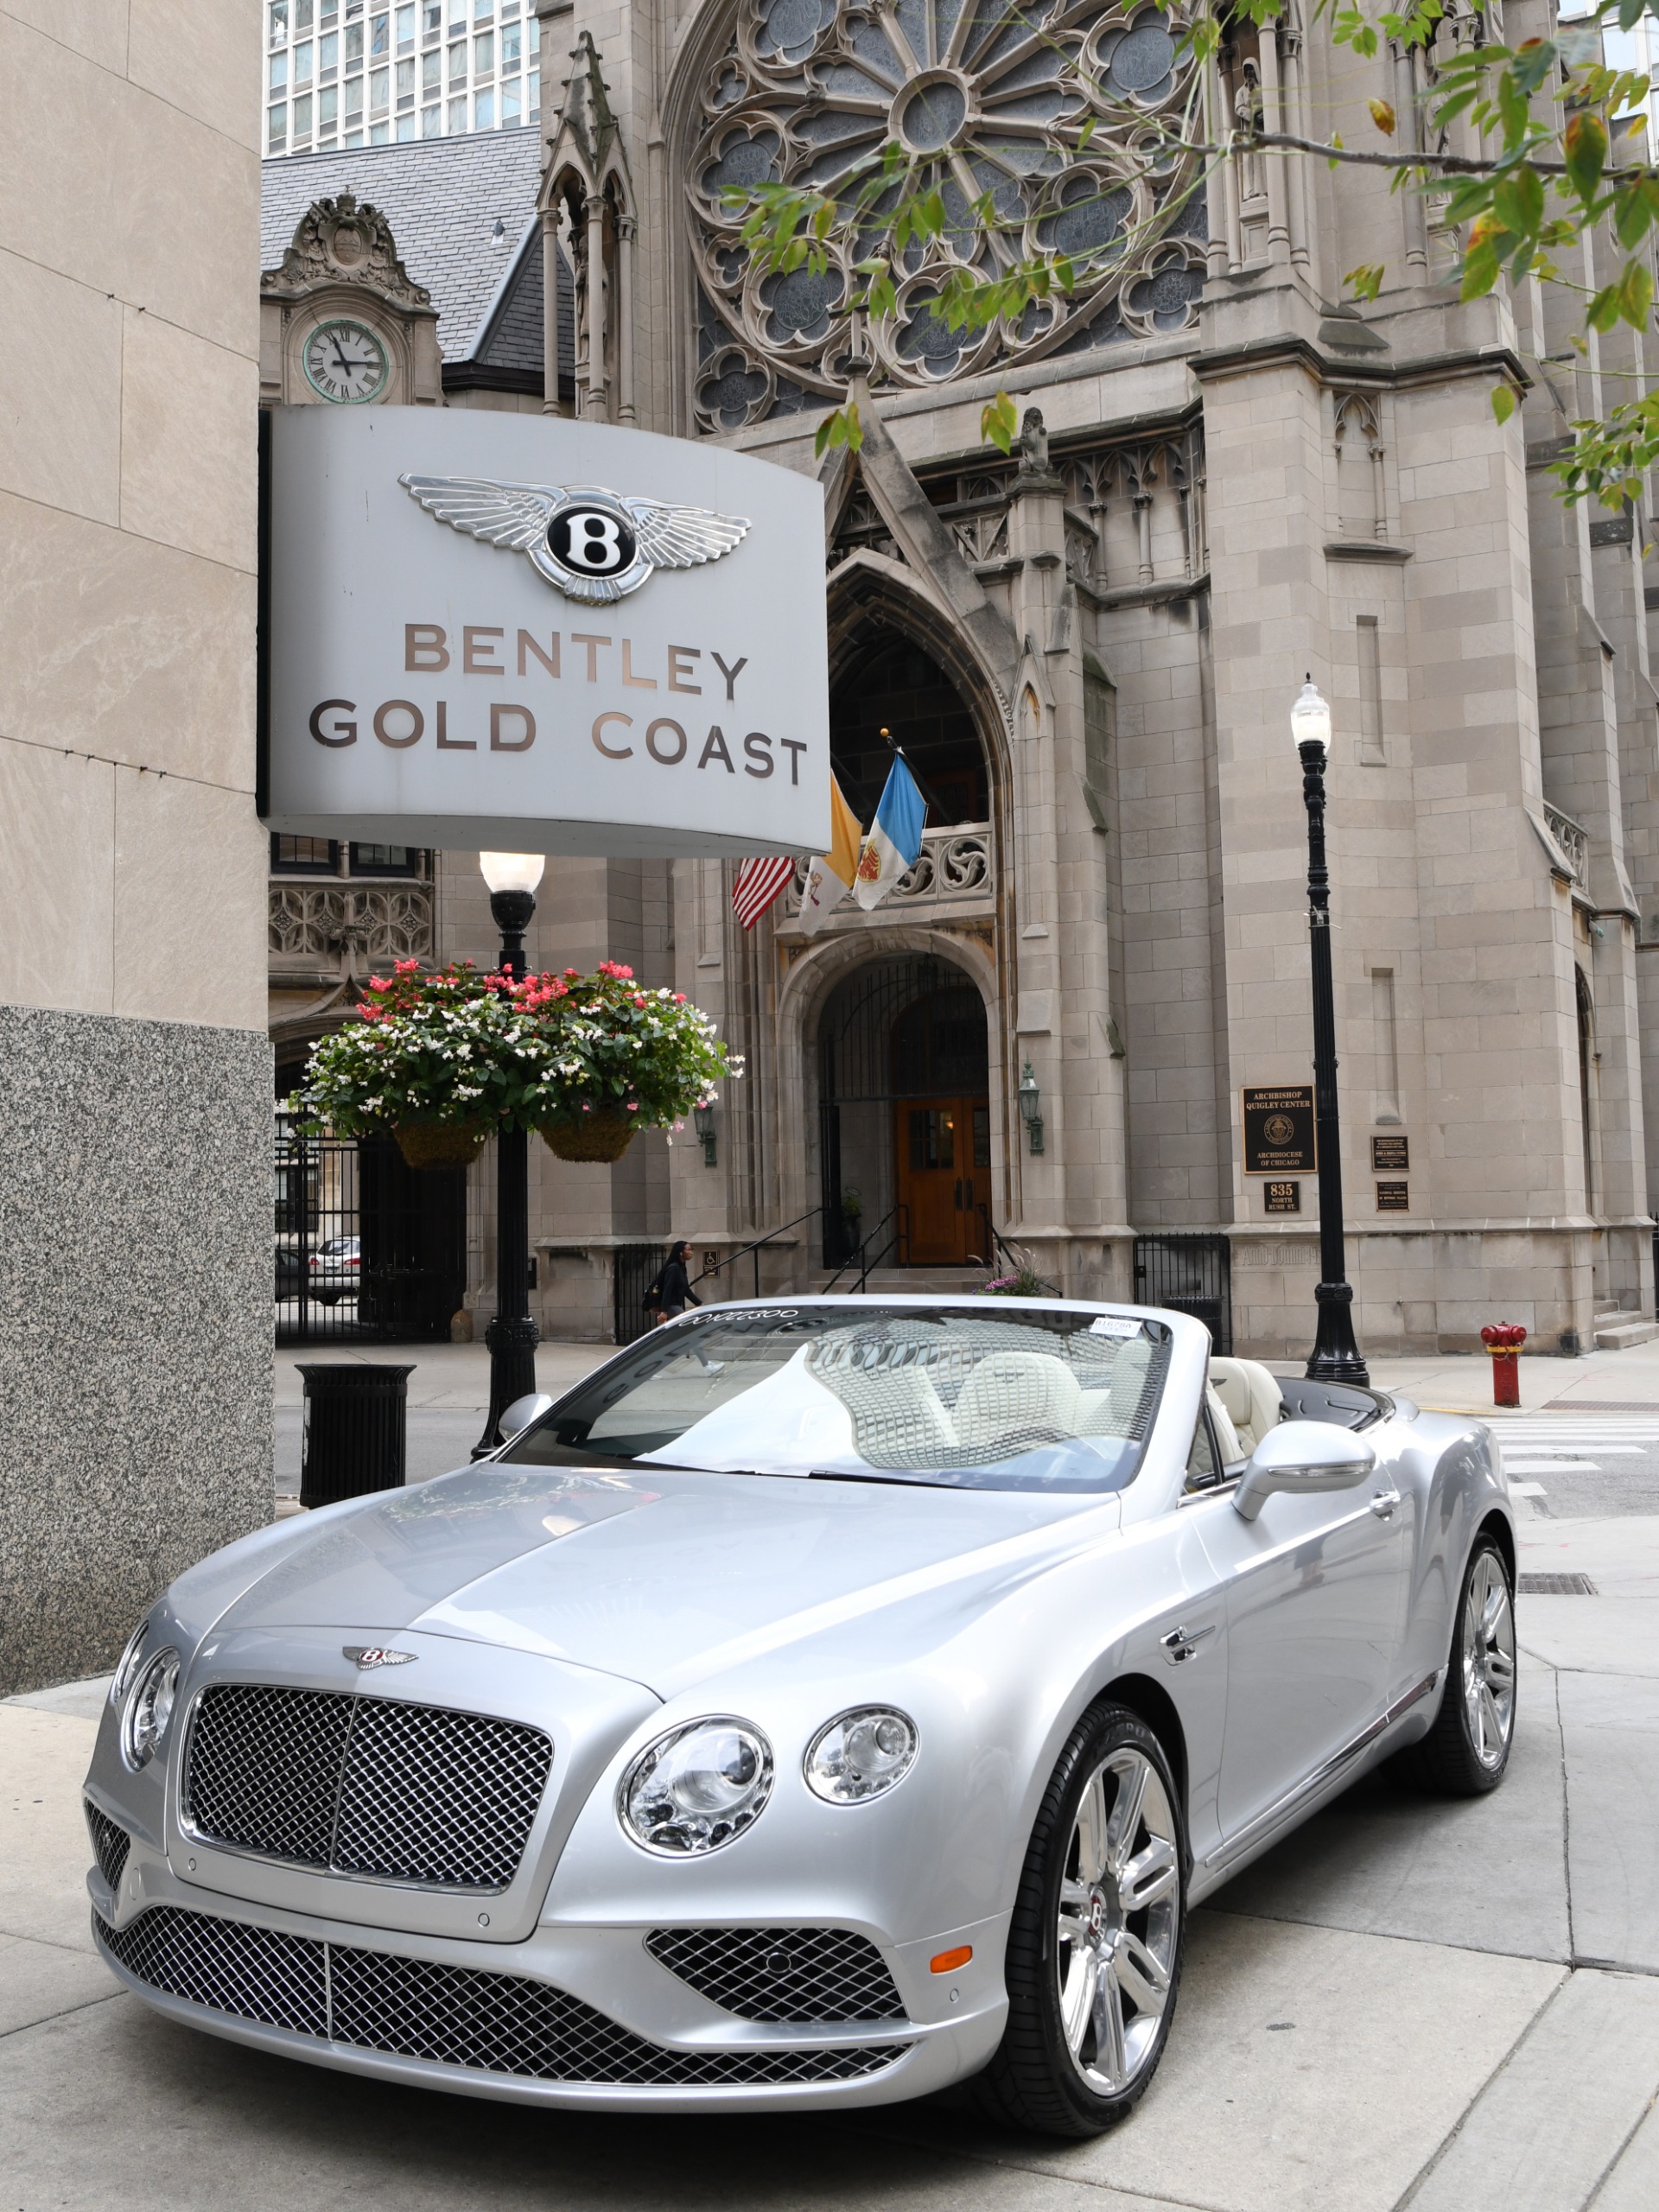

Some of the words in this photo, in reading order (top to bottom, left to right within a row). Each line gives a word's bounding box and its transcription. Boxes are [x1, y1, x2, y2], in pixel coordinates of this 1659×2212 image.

[566, 513, 621, 569] B
[404, 623, 748, 701] BENTLEY
[309, 698, 537, 752] GOLD
[591, 711, 807, 785] COAST
[1254, 1091, 1302, 1100] ARCHBISHOP
[1246, 1102, 1279, 1110] QUIGLEY
[1271, 1184, 1293, 1197] 835
[362, 1649, 380, 1662] B
